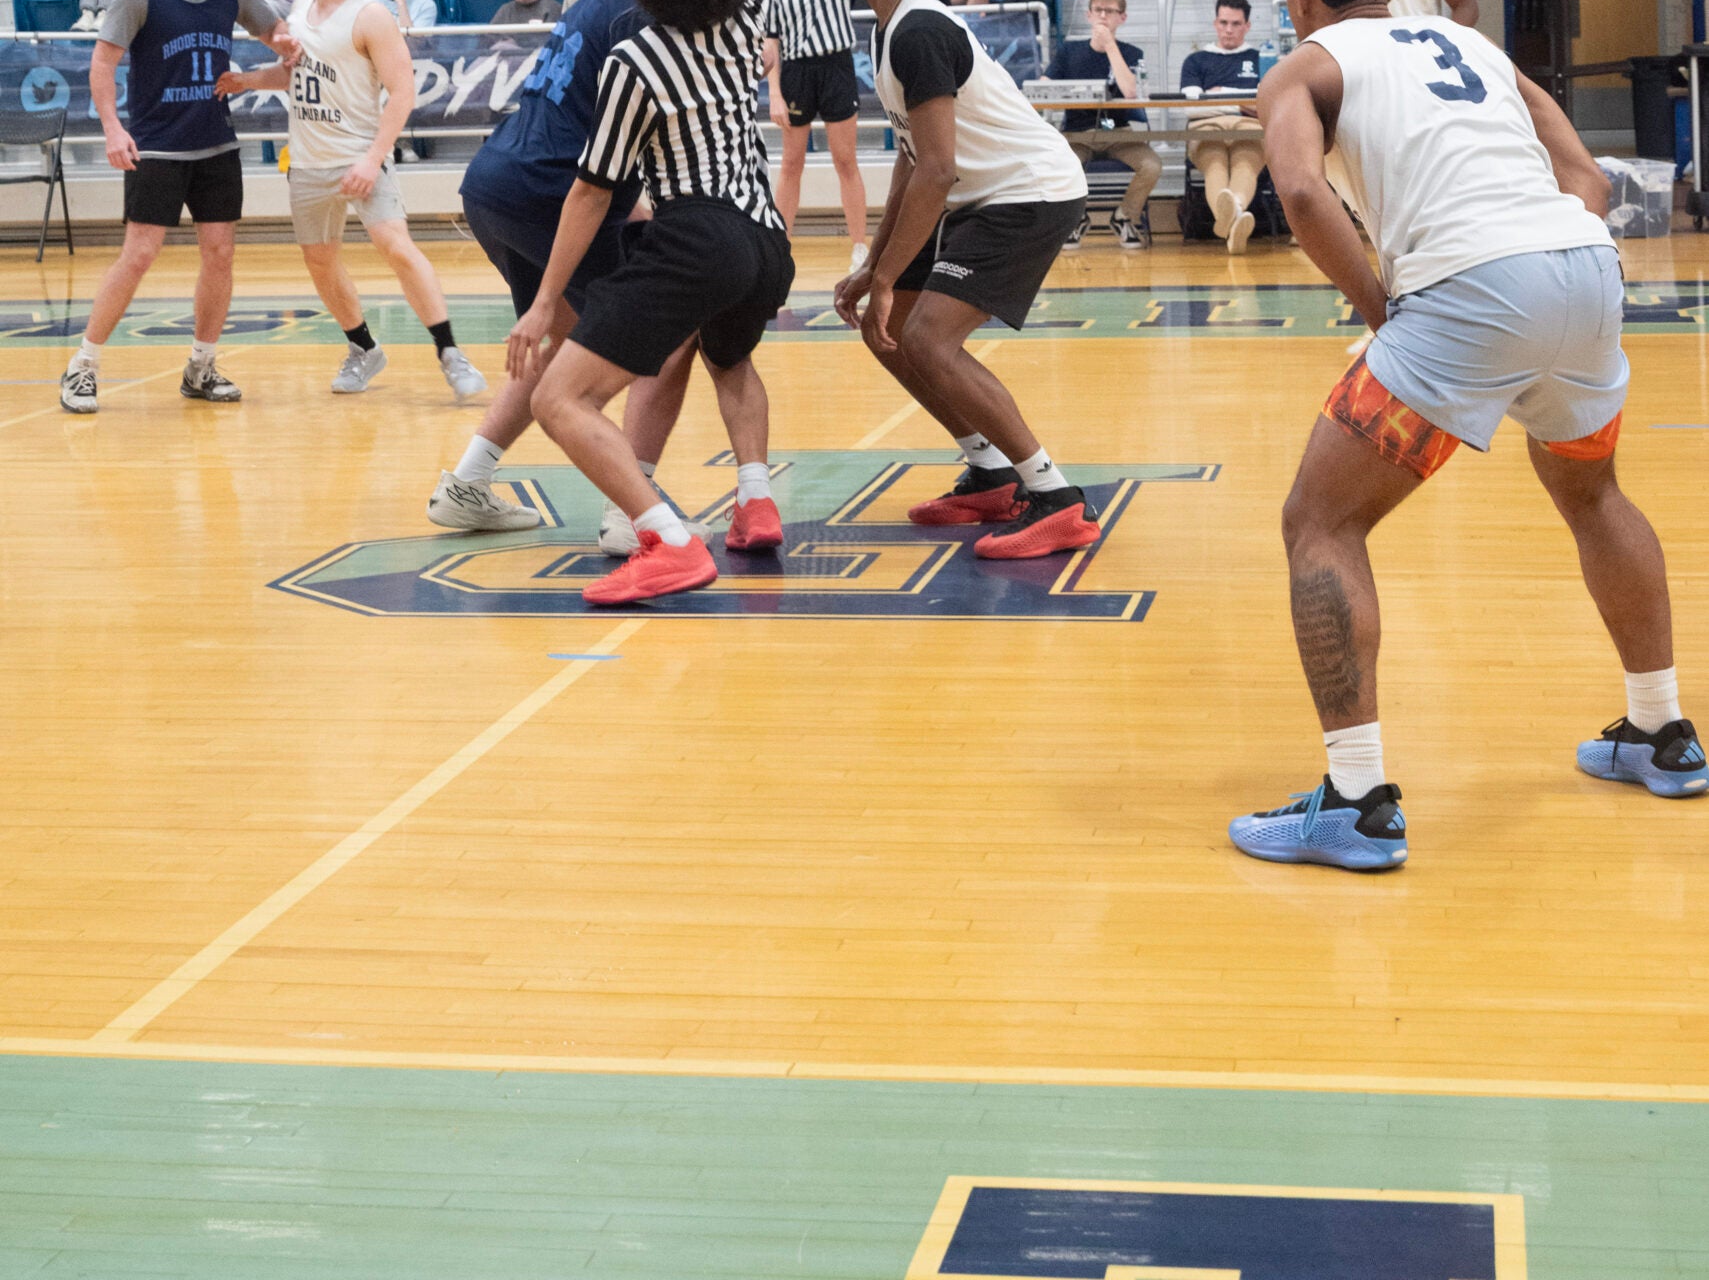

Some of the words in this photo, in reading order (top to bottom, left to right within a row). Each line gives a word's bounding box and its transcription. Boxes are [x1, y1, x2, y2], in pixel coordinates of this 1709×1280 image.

[162, 33, 197, 60] RHODE
[191, 51, 214, 81] 11
[1389, 29, 1488, 104] 3
[294, 71, 321, 104] 20
